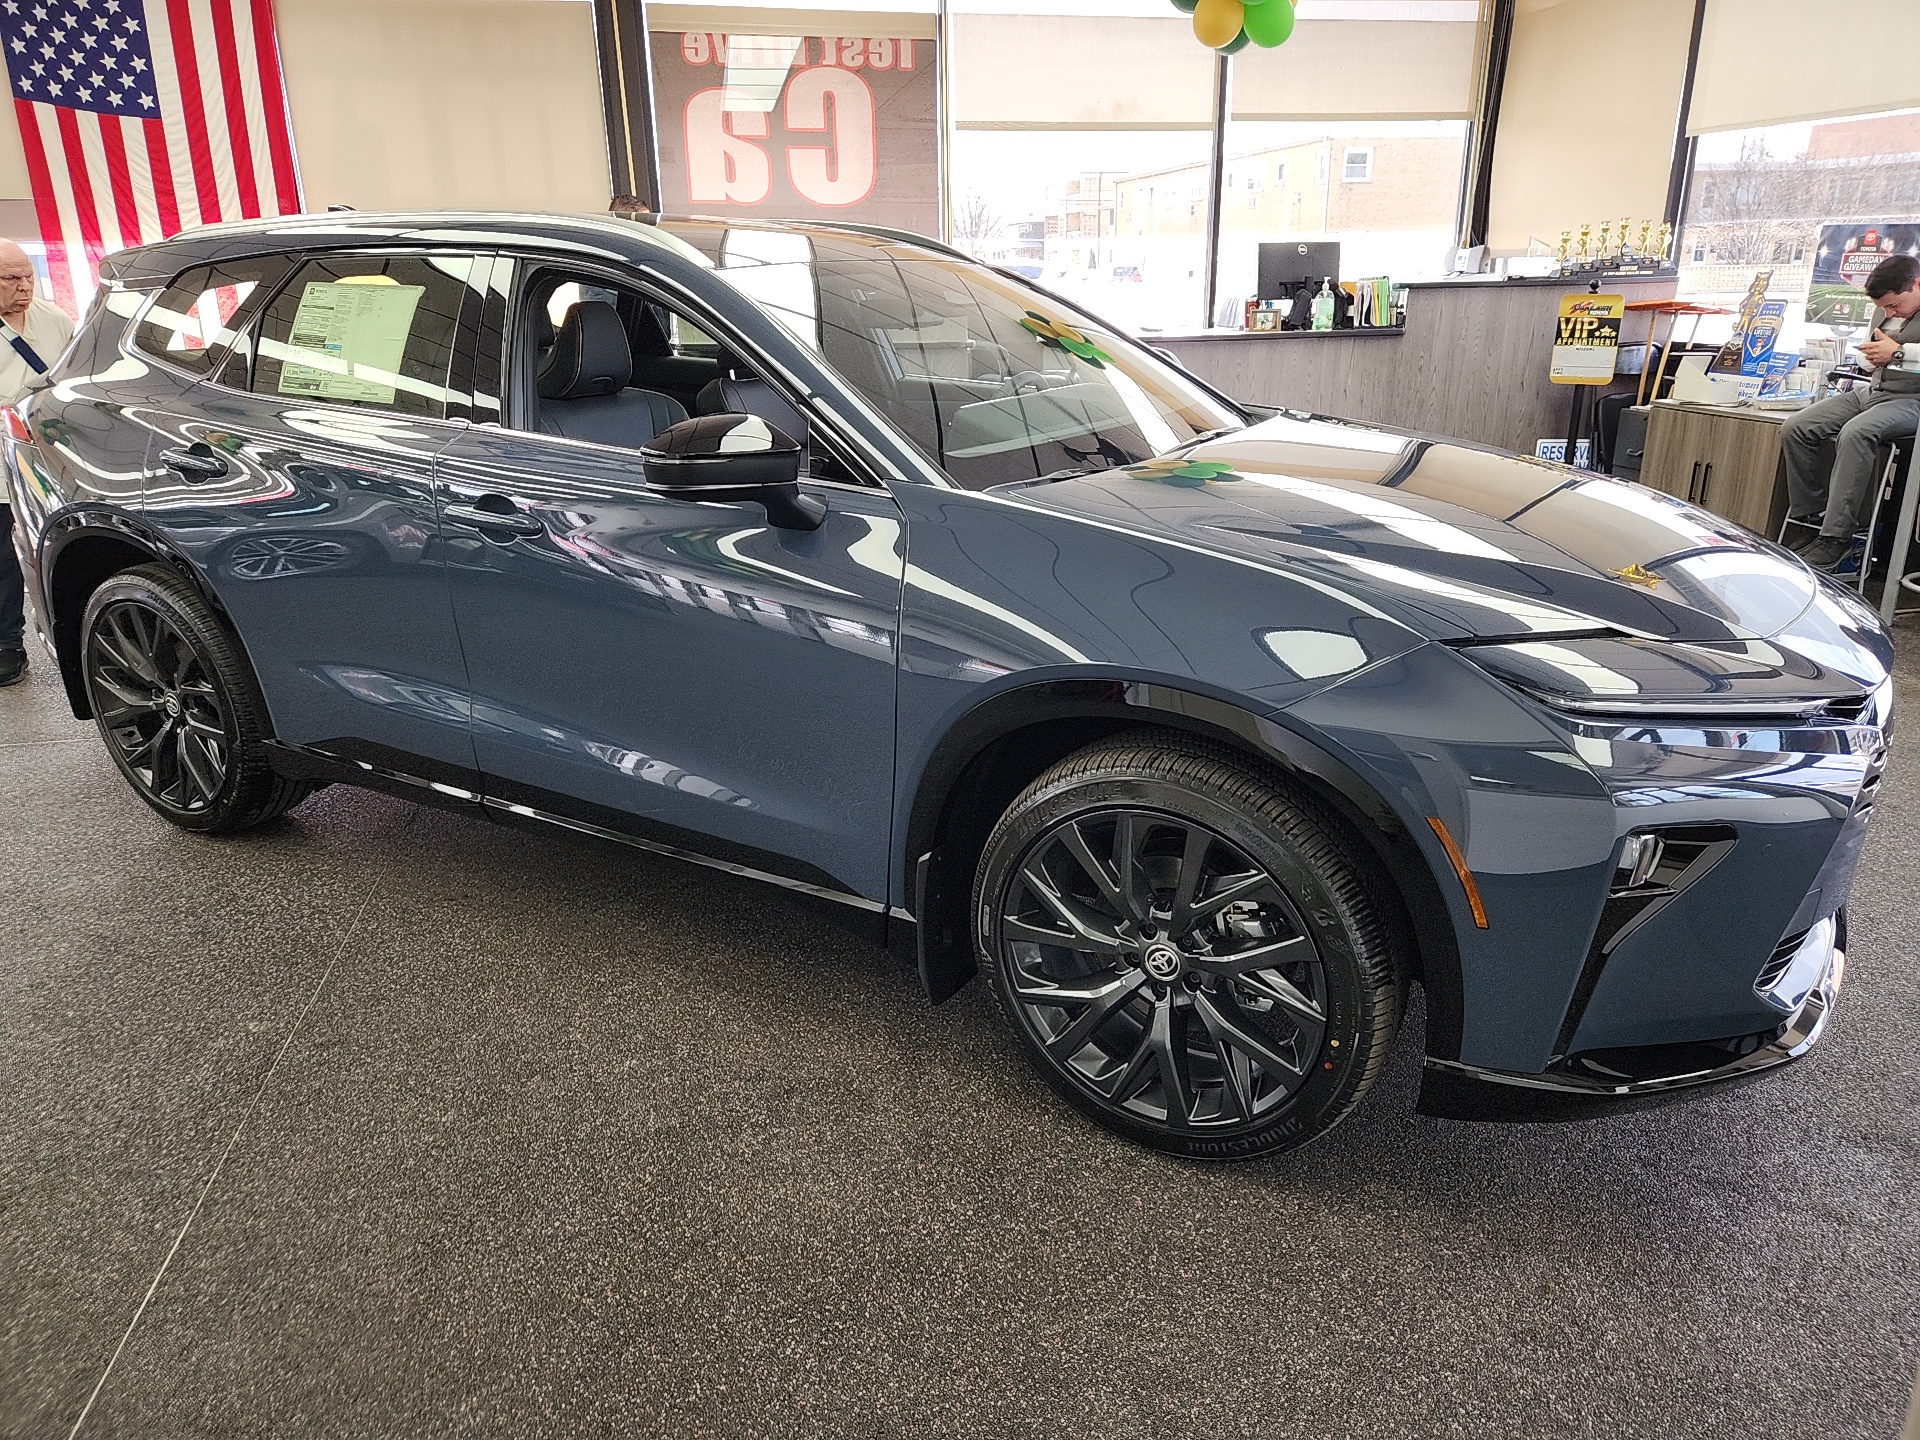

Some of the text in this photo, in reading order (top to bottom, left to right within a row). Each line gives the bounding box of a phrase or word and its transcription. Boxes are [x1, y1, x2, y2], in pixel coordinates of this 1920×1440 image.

[1848, 255, 1884, 263] GAMEDAY
[1843, 263, 1878, 271] GIVEAWA
[1560, 317, 1599, 338] VIP
[1556, 338, 1616, 347] APPOINTMENT
[1739, 381, 1759, 390] tomers
[1015, 782, 1122, 843] BRIDGESTONE
